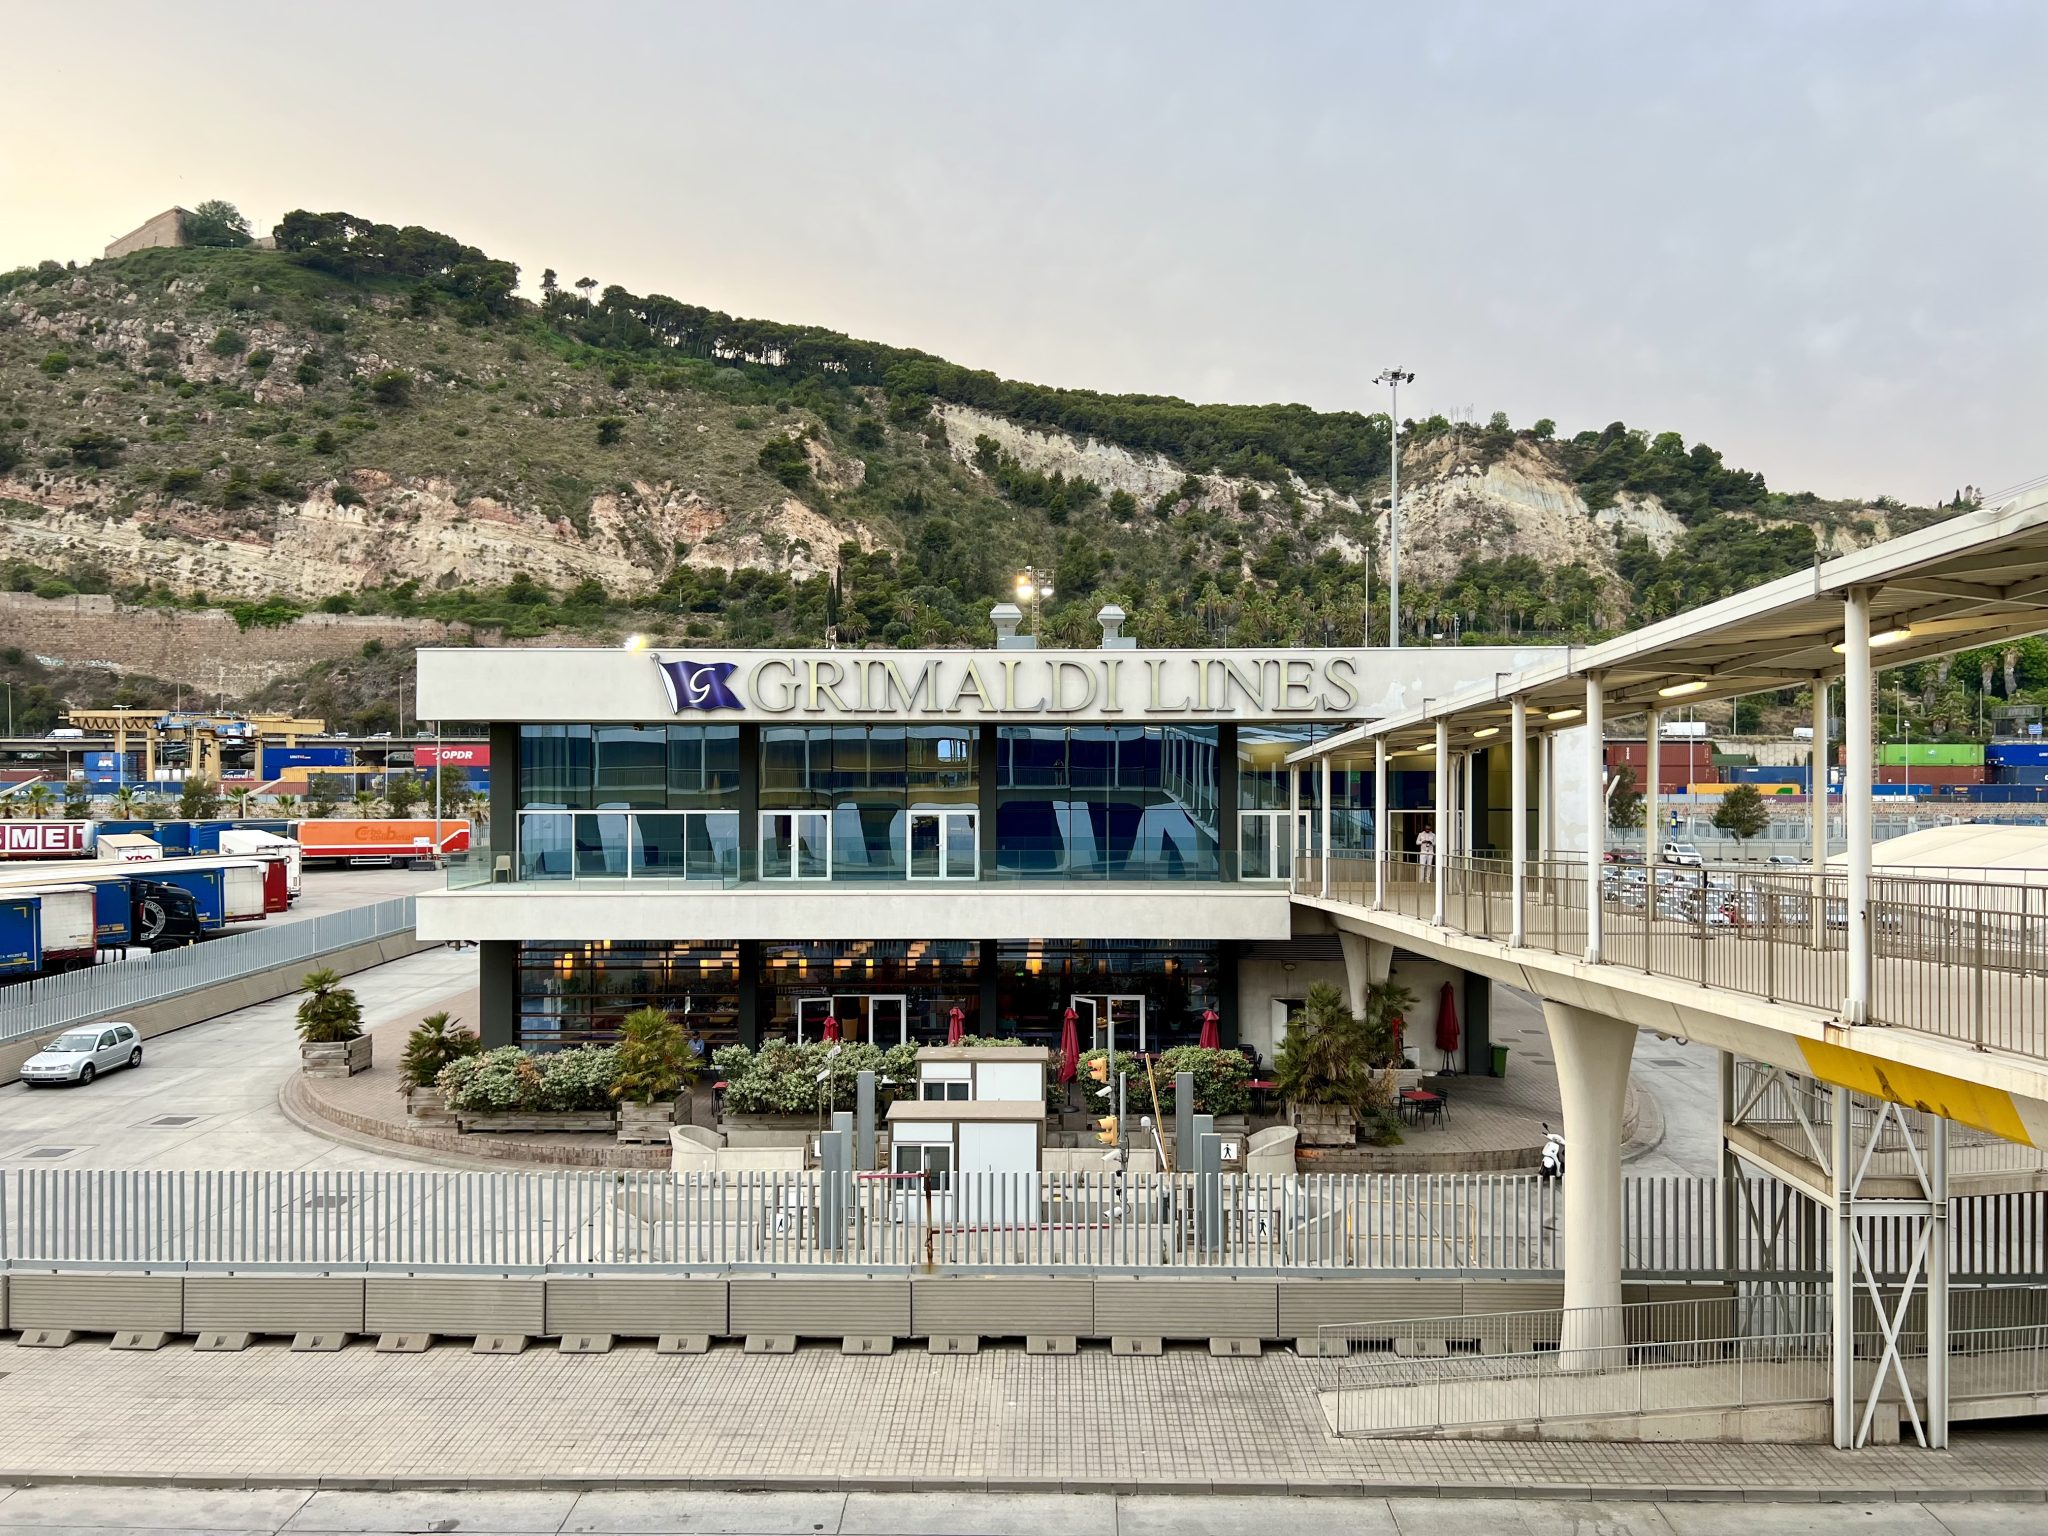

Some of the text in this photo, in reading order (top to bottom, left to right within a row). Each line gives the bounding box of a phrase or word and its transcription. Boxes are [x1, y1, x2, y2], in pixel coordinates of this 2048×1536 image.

[747, 656, 1360, 713] GRIMALDI LINES
[441, 750, 473, 760] OPDR
[0, 828, 84, 849] ME
